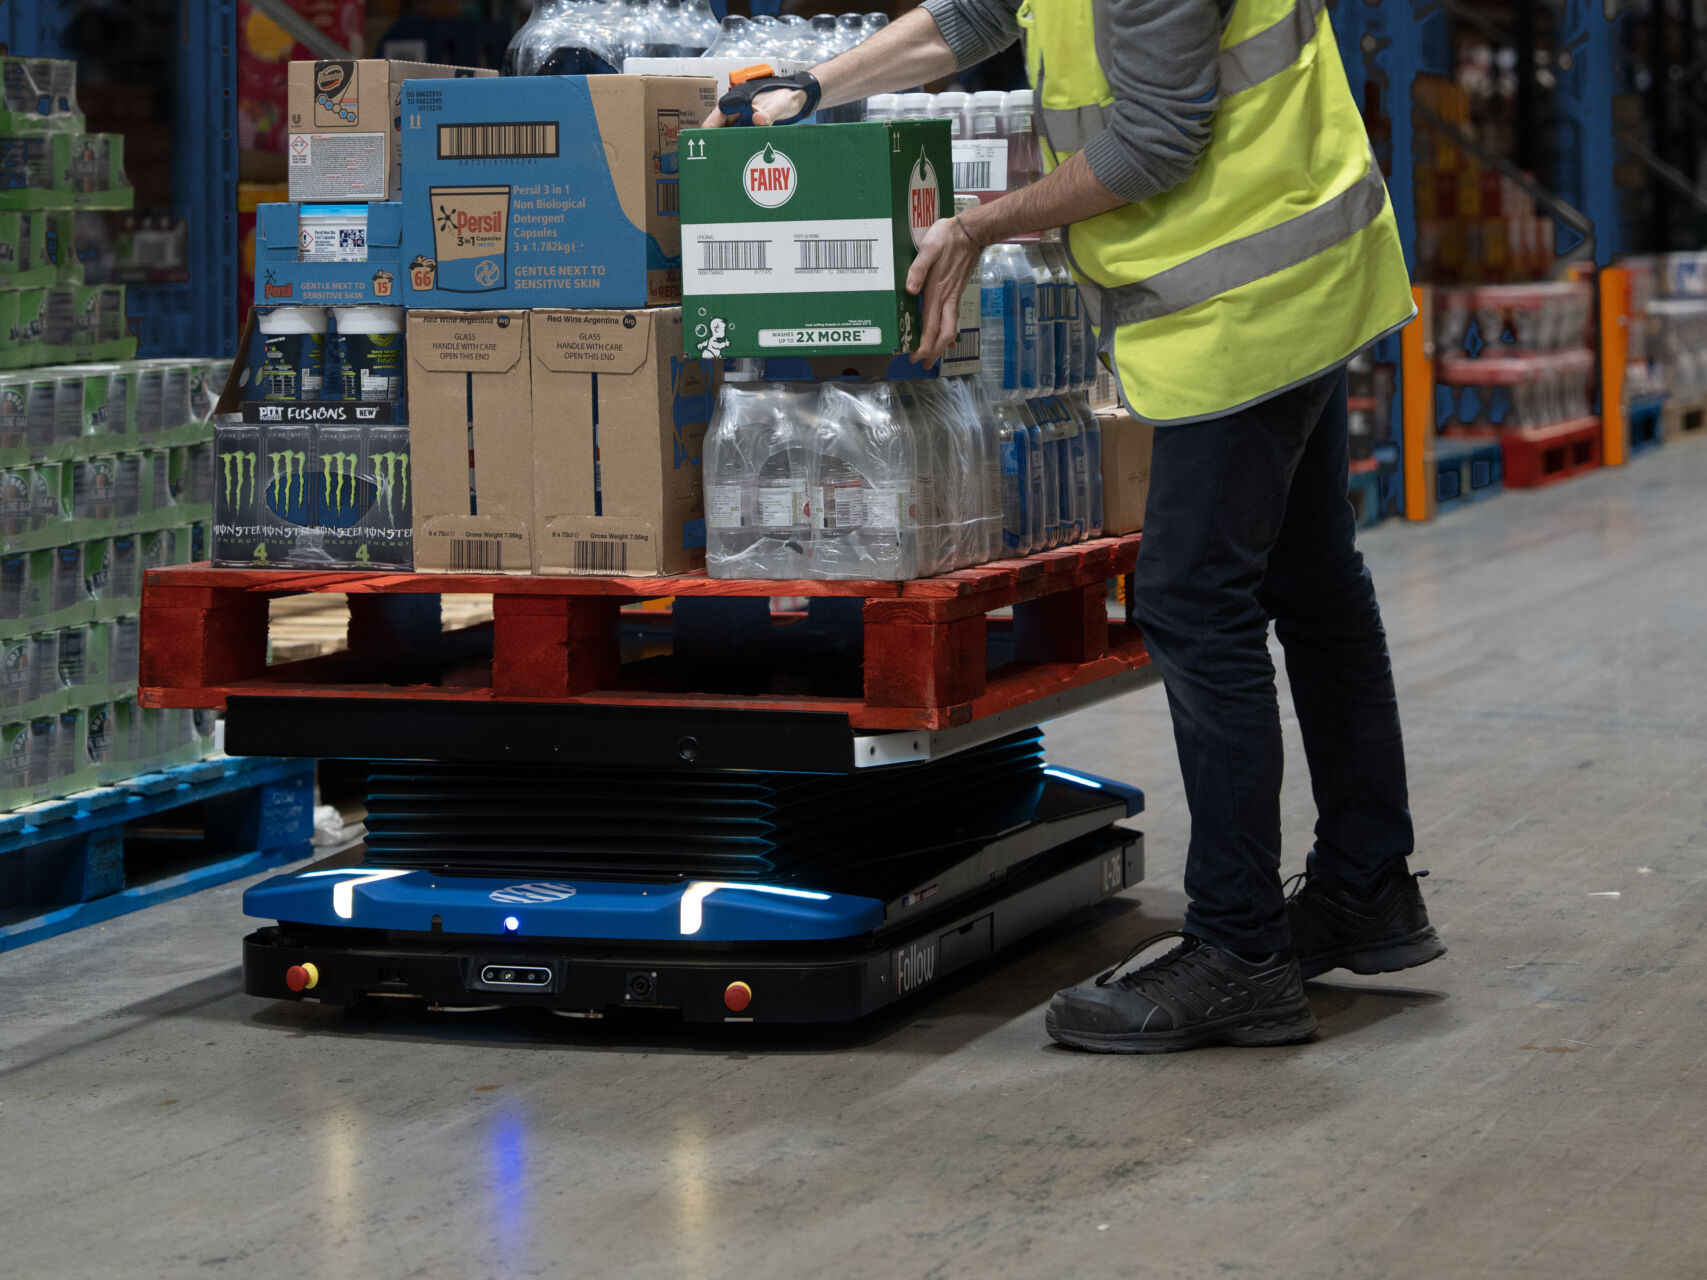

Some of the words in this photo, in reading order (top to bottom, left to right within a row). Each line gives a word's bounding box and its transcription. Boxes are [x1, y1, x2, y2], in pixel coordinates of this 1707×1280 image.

[750, 167, 790, 192] FAIRY
[513, 184, 541, 195] Persil
[544, 184, 550, 194] 3
[552, 184, 562, 194] in
[565, 184, 570, 194] 1
[513, 199, 534, 210] Non
[536, 198, 586, 212] Biological
[912, 187, 936, 229] FAIRY
[456, 211, 502, 236] Persil
[513, 213, 566, 226] Detergent
[513, 228, 558, 240] Capsules
[514, 242, 520, 252] 3
[522, 244, 529, 252] x
[531, 241, 571, 254] 1.782kg
[514, 266, 556, 277] GENTLE
[558, 265, 589, 276] NEXT
[590, 264, 606, 276] TO
[414, 271, 432, 287] 66
[514, 279, 572, 290] SENSITIVE
[574, 279, 601, 289] SKIN
[264, 282, 292, 300] Persil
[354, 281, 366, 290] TO
[378, 282, 388, 294] 15
[659, 285, 682, 298] REFIL
[423, 316, 438, 324] Red
[439, 316, 456, 324] Wine
[458, 317, 494, 326] Argentina
[548, 315, 562, 323] Red
[563, 316, 582, 324] Wine
[584, 317, 620, 326] Argentina
[454, 333, 476, 341] GLASS
[578, 332, 601, 341] GLASS
[796, 331, 815, 343] 2X
[432, 342, 460, 350] HANDLE
[480, 343, 497, 351] CARE
[556, 342, 586, 350] HANDLE
[586, 343, 604, 351] WITH
[605, 344, 623, 352] CARE
[440, 352, 458, 360] OPEN
[474, 353, 490, 361] END
[564, 352, 584, 360] OPEN
[584, 352, 599, 360] THIS
[600, 352, 615, 361] END
[288, 407, 347, 420] FUSIONS
[359, 409, 374, 417] NEW
[484, 532, 503, 540] Weight
[253, 542, 268, 561] 4
[356, 544, 370, 562] 4
[898, 943, 935, 996] Follow
